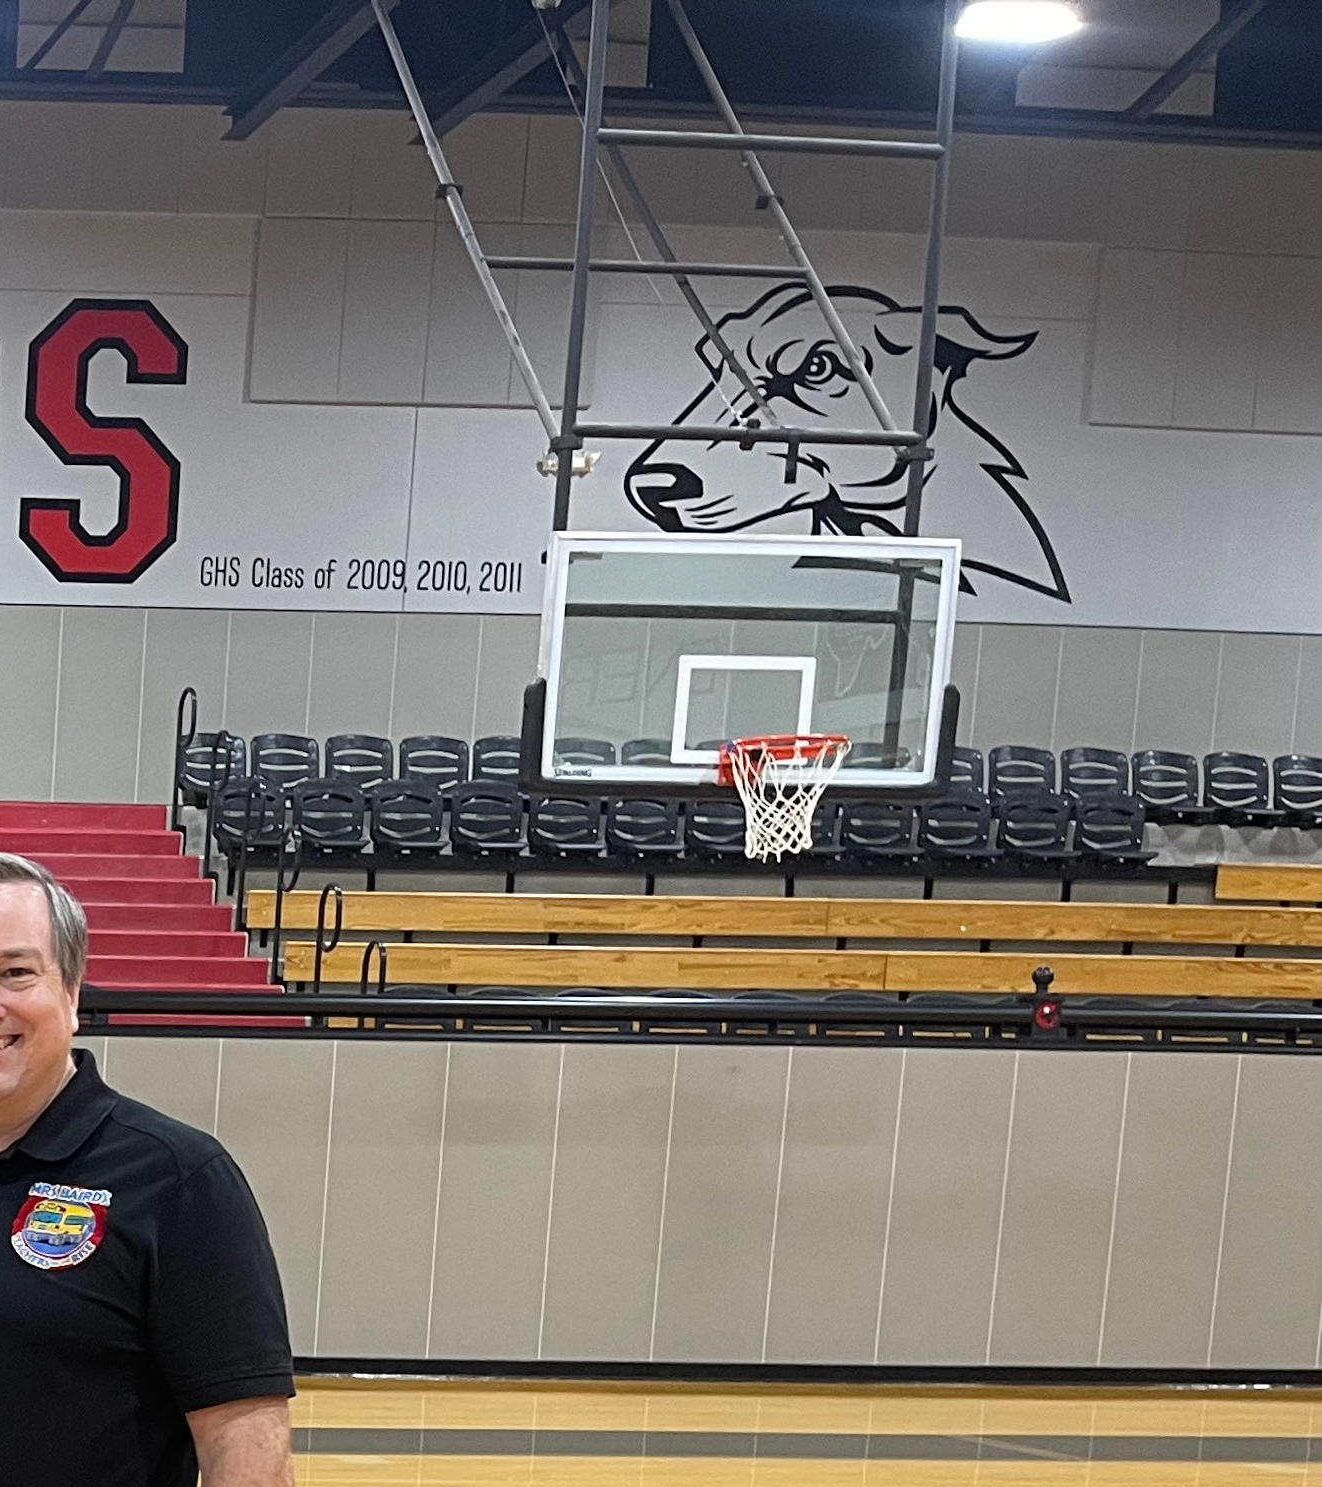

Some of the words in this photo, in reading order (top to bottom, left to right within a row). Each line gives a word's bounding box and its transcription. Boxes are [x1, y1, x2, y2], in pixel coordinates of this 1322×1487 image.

[200, 557, 240, 587] GHS
[251, 557, 304, 589] Class
[314, 559, 337, 589] of
[347, 559, 408, 593] 2009,
[417, 560, 471, 595] 2010,
[479, 561, 522, 593] 2011
[32, 1183, 58, 1197] MRS
